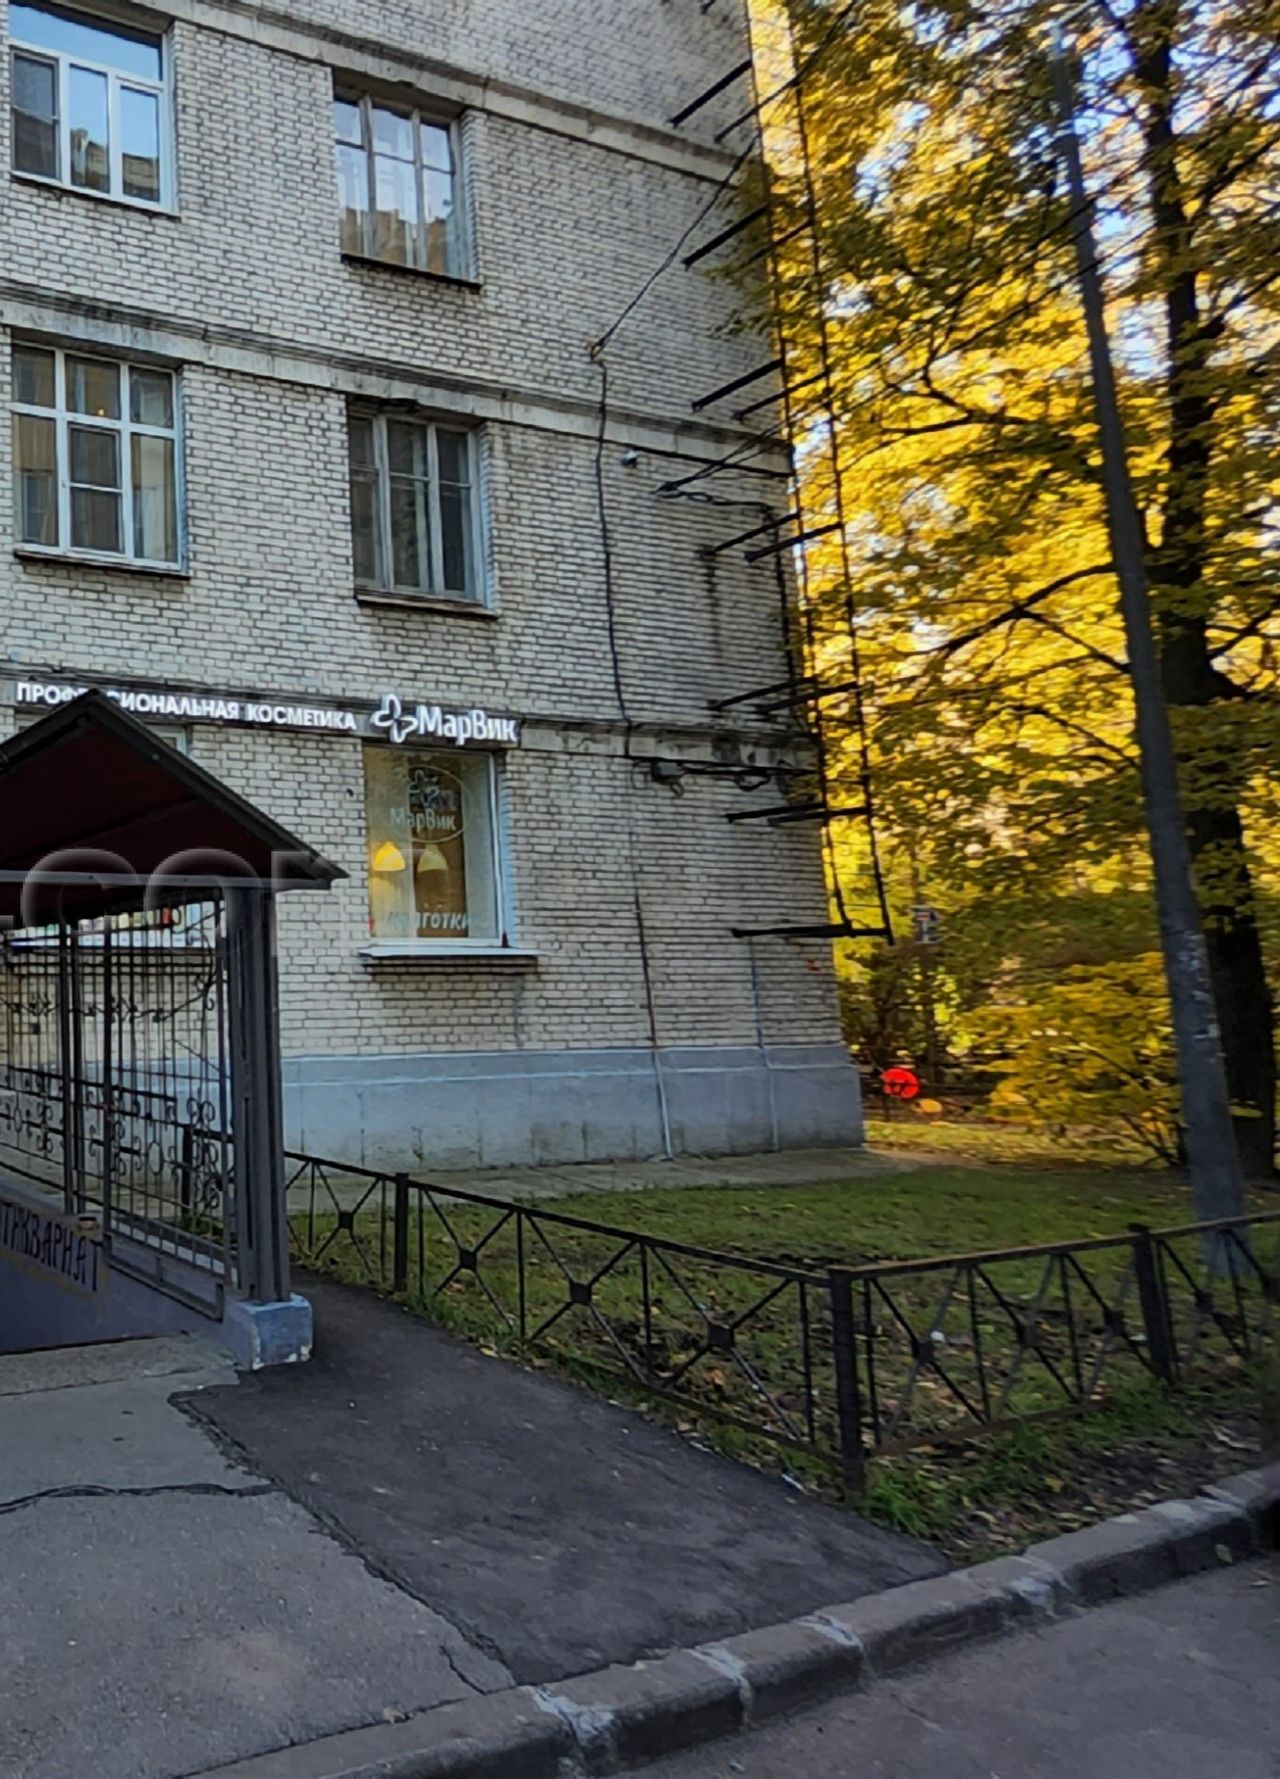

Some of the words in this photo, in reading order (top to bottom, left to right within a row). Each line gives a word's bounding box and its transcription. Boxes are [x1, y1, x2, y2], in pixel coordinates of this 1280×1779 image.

[17, 682, 240, 719] ПРОФИОНАЛЬНАЯ
[247, 704, 357, 731] КОСМЕТИКА
[418, 704, 518, 744] МарВик
[390, 807, 456, 833] МарВик
